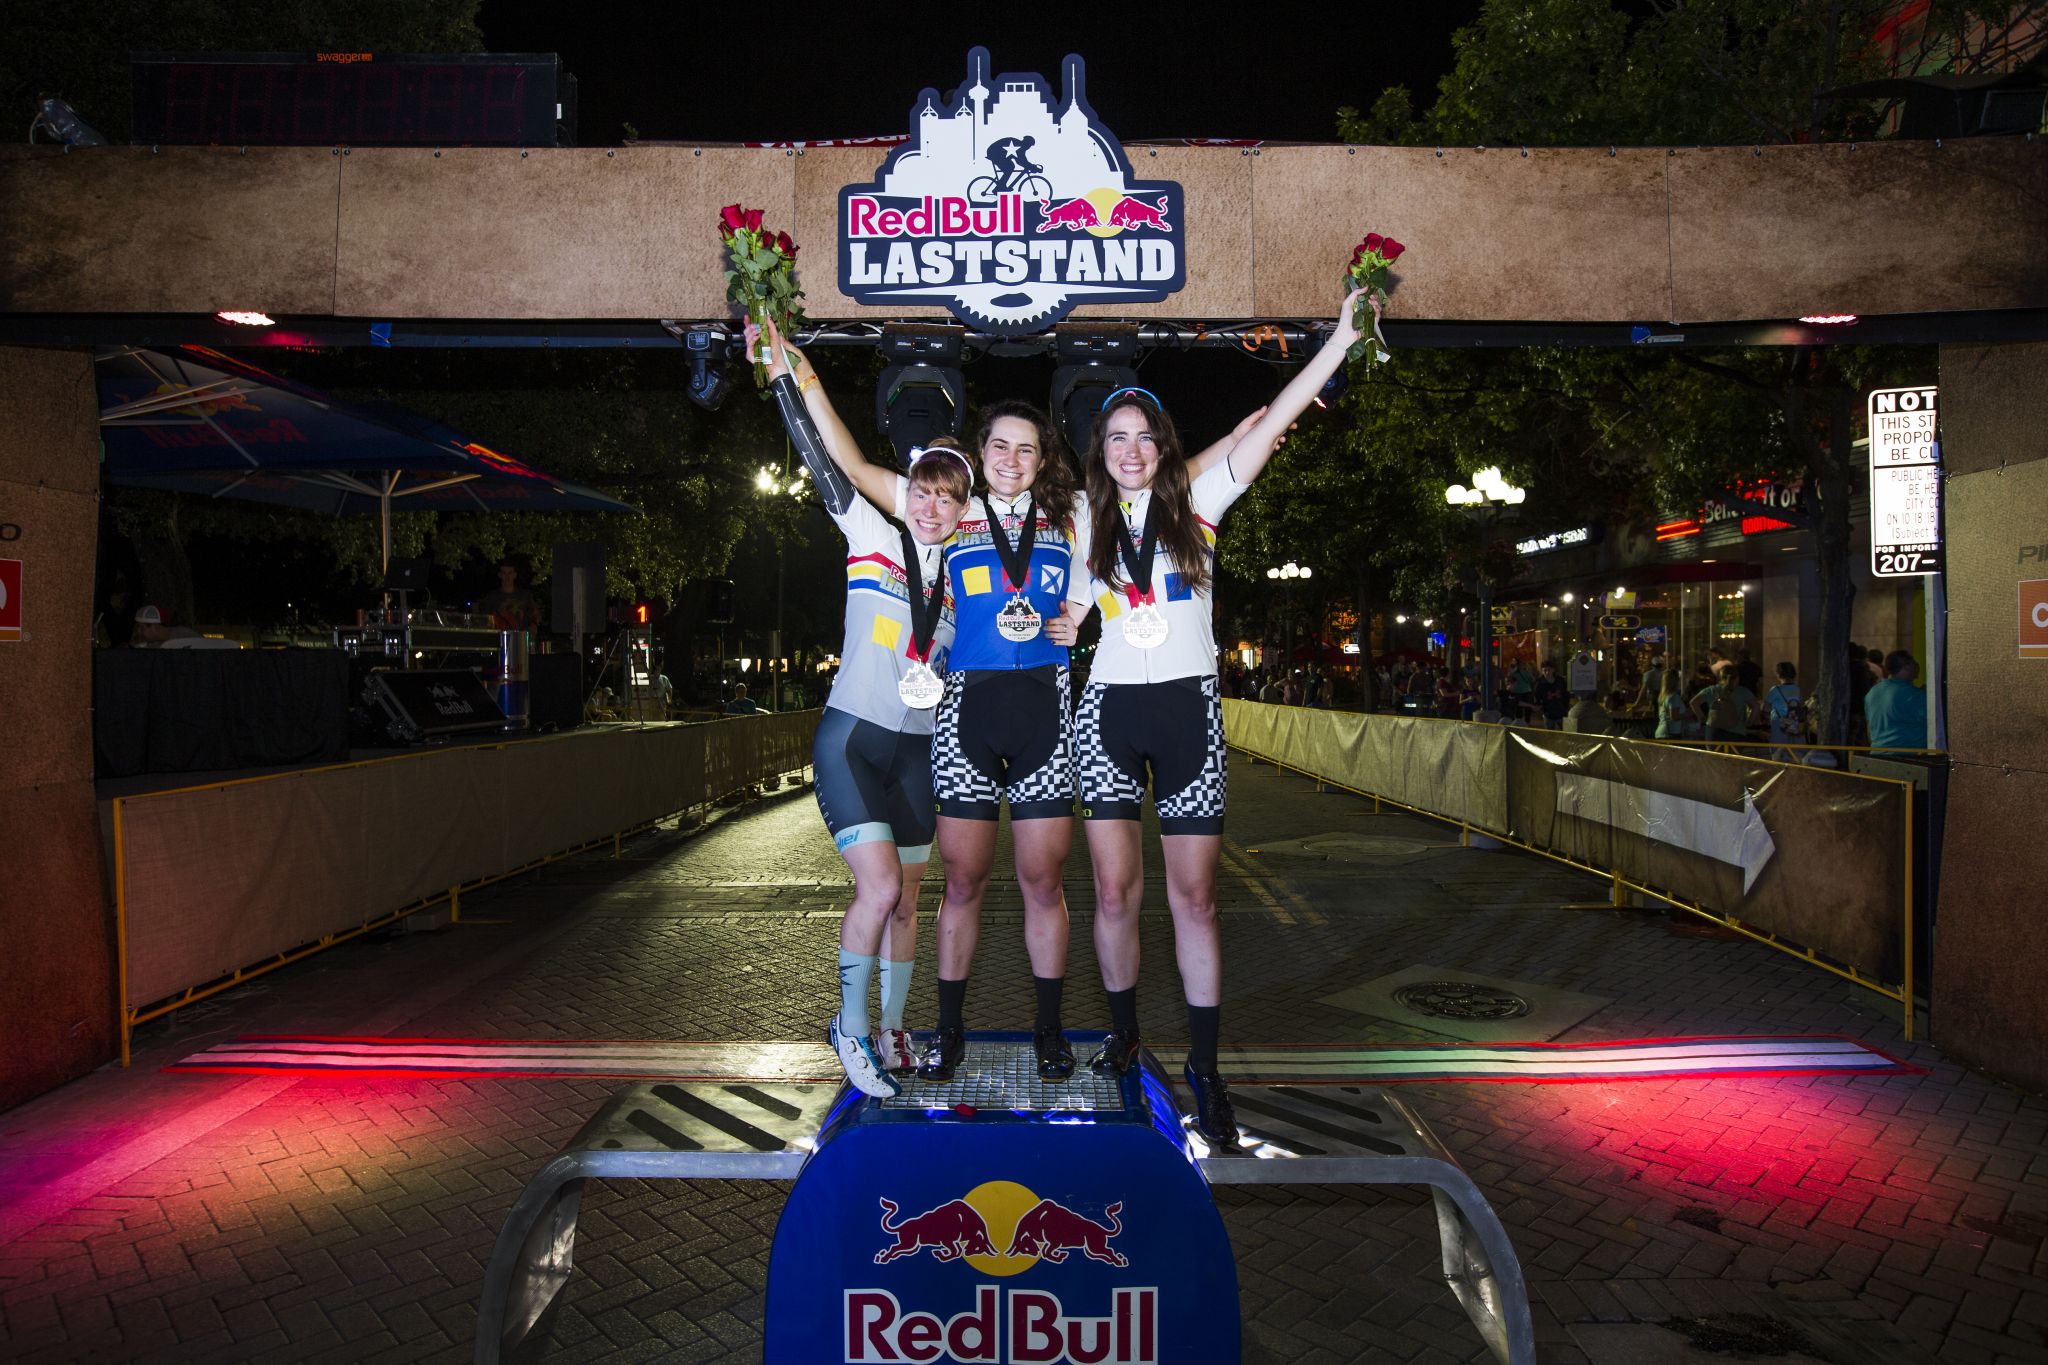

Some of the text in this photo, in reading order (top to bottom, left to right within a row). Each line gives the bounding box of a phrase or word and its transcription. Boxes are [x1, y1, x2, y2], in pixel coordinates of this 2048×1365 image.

[848, 194, 1024, 238] Red Bull
[848, 239, 1176, 286] LASTSTAND
[1877, 391, 1938, 413] NOT
[1880, 414, 1935, 430] THIS ST
[1883, 430, 1933, 445] PROPO
[1891, 446, 1939, 461] BE CL
[1891, 469, 1923, 482] PUBLIC
[1908, 483, 1920, 495] BE
[1905, 498, 1924, 510] CITY
[1886, 513, 1898, 525] ON
[1879, 554, 1936, 573] 207-
[637, 606, 646, 623] 1
[999, 620, 1040, 628] LASTSTAND
[844, 1285, 1158, 1365] Red Bull
